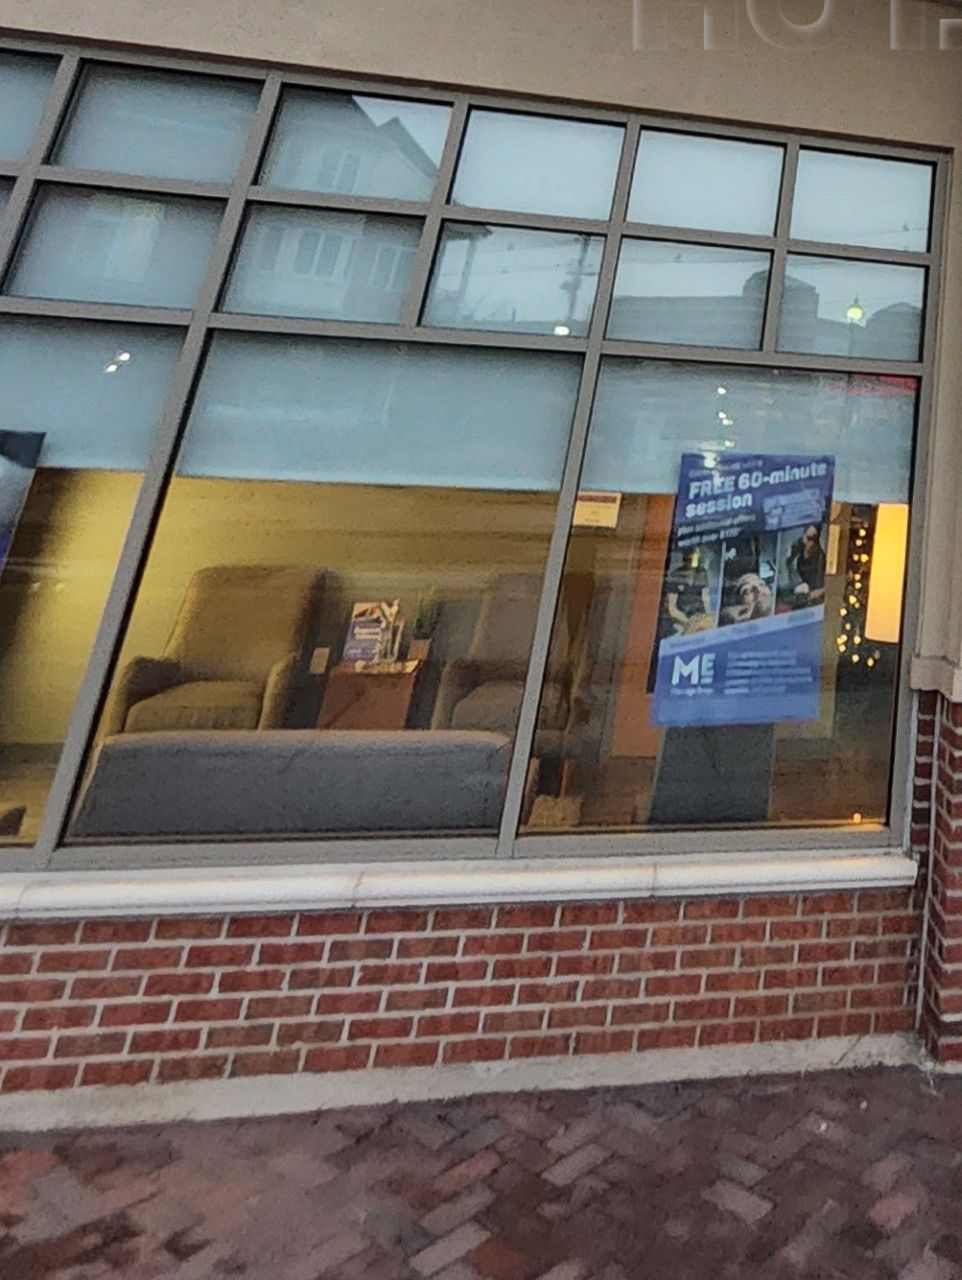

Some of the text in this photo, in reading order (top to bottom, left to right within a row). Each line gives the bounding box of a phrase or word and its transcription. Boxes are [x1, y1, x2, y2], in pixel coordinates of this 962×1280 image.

[688, 461, 828, 500] FREE 60-minute
[685, 492, 753, 519] session
[671, 652, 716, 686] ME
